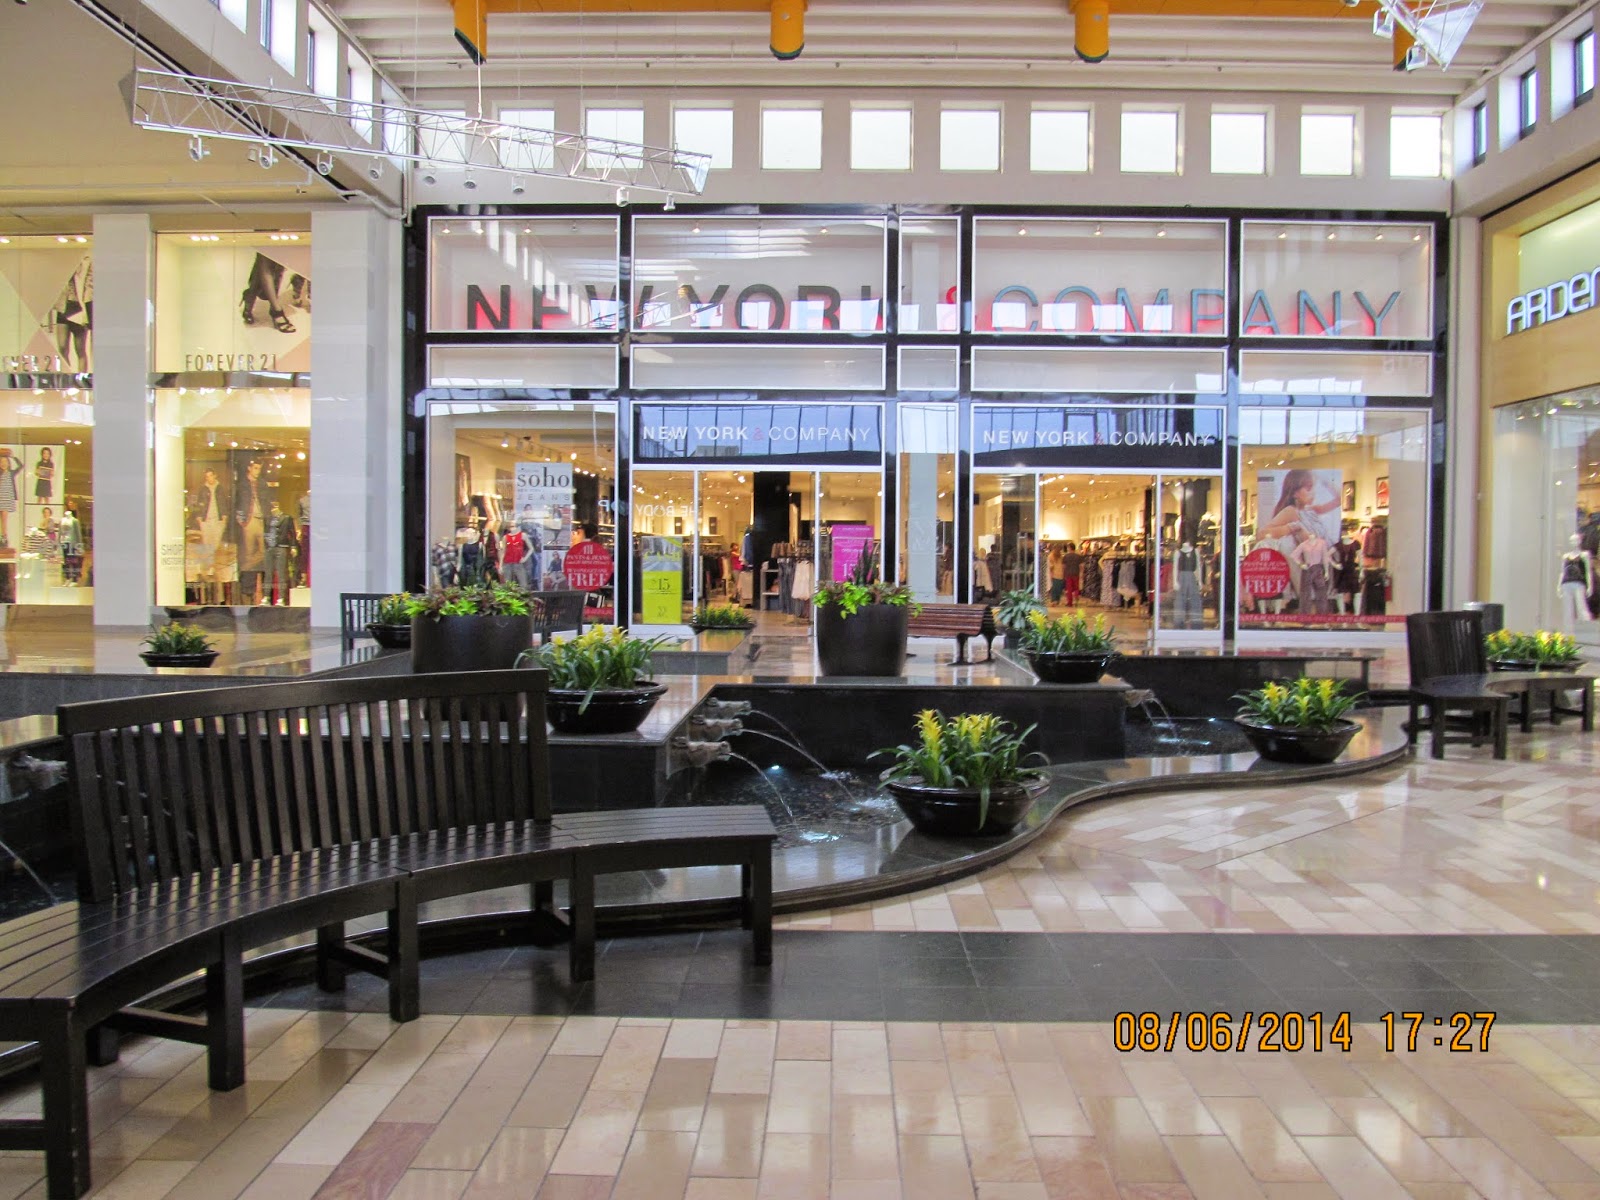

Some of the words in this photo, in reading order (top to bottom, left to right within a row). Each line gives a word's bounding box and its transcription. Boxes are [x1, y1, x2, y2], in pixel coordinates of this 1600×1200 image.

[992, 285, 1400, 336] COMPANY
[185, 354, 255, 371] FOREVER
[260, 354, 277, 371] 21
[643, 426, 688, 440] NEW
[697, 426, 748, 440] YORK
[768, 426, 872, 441] COMPANY
[983, 430, 1028, 444] NEW
[1037, 431, 1089, 445] YORK
[1109, 431, 1213, 447] COMPANY
[517, 466, 570, 488] soho
[567, 573, 608, 587] FREE
[1245, 579, 1285, 594] FREE
